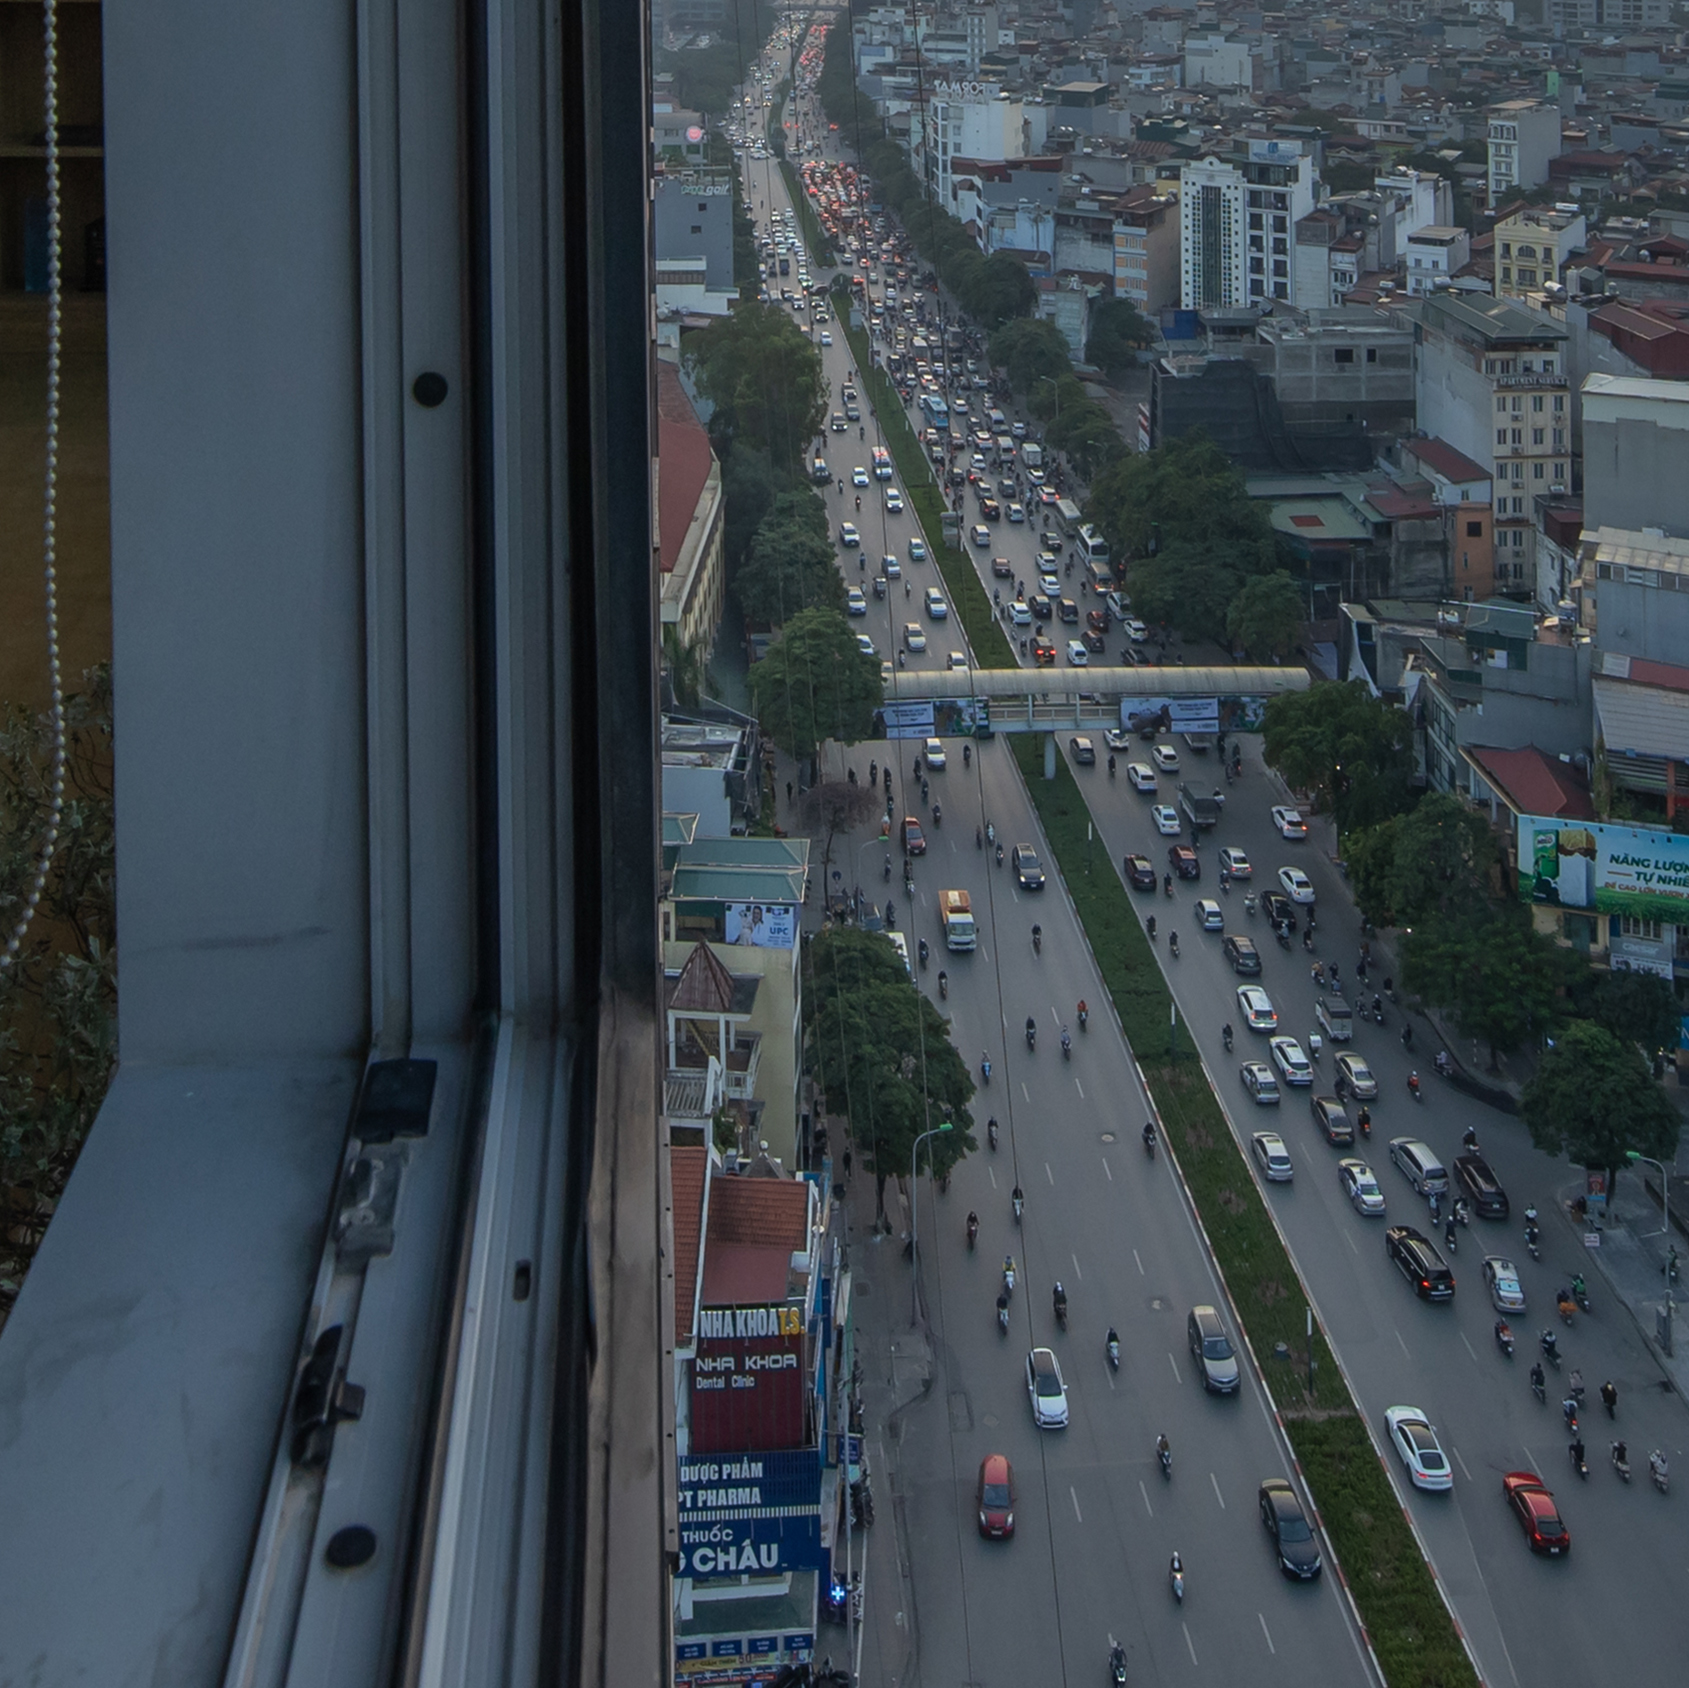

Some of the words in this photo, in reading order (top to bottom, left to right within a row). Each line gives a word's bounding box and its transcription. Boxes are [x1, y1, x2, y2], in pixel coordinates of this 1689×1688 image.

[1609, 852, 1651, 868] NĂNG
[1618, 883, 1637, 892] CAO
[1635, 871, 1655, 885] TỰ
[769, 927, 788, 935] UPC
[700, 1310, 734, 1338] NHA
[735, 1309, 779, 1337] KHOA
[696, 1356, 735, 1373] NHA
[745, 1353, 797, 1370] KHOA
[696, 1375, 725, 1389] Dental
[731, 1375, 755, 1388] Clinic
[680, 1462, 719, 1484] DƯỢC
[697, 1487, 761, 1508] PHARMA
[682, 1524, 733, 1544] THUỐC
[692, 1538, 779, 1572] CHÂU
